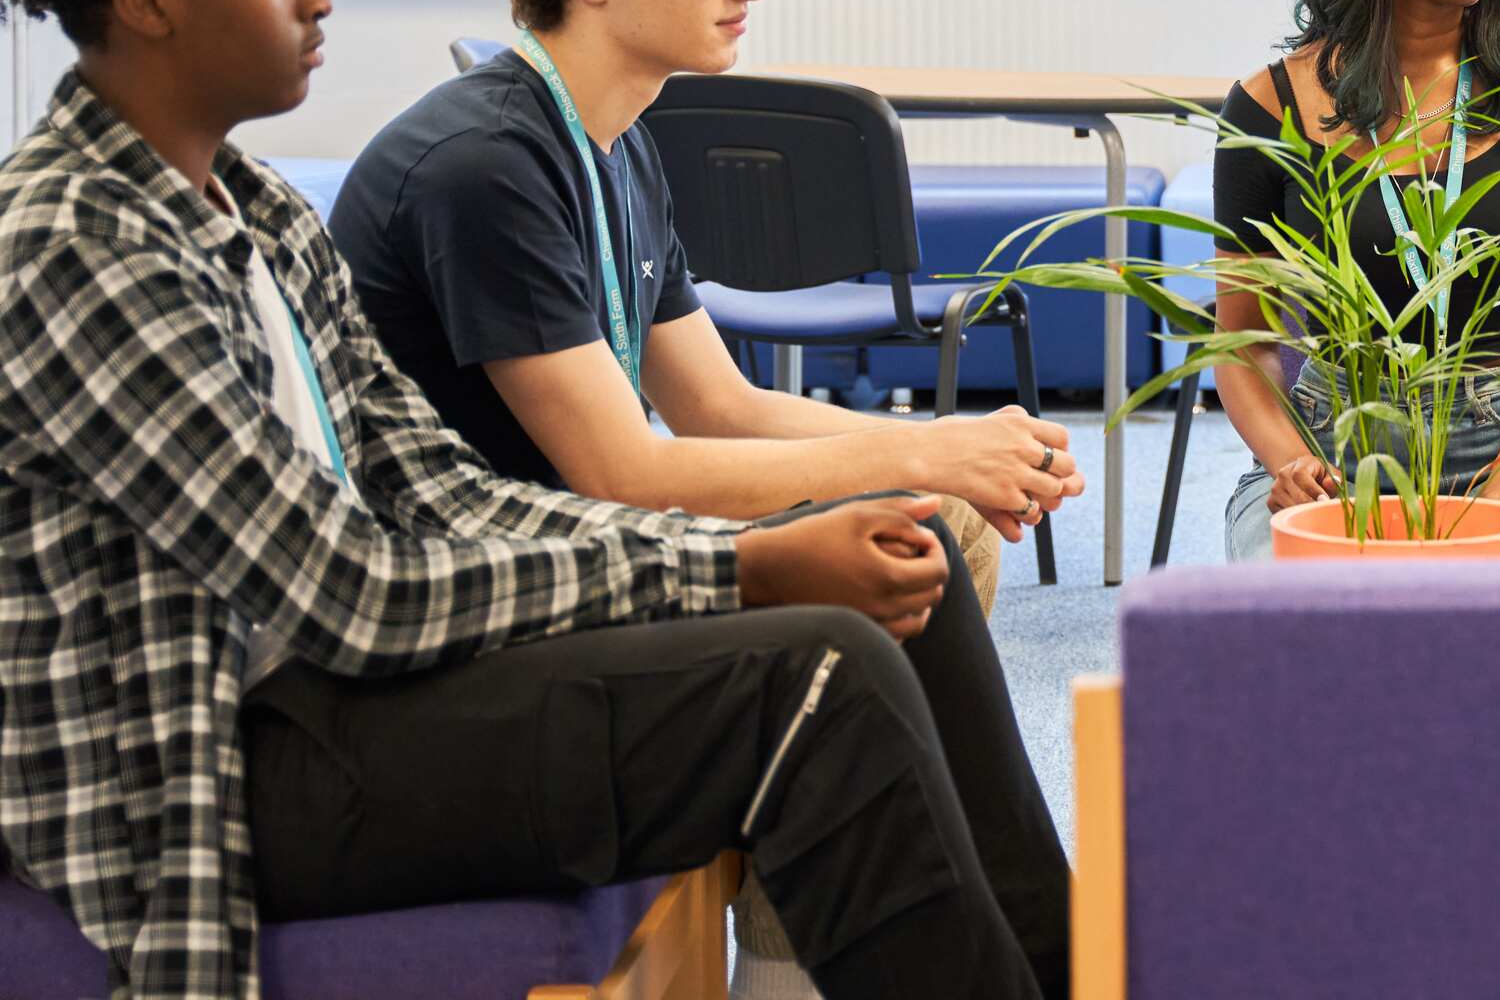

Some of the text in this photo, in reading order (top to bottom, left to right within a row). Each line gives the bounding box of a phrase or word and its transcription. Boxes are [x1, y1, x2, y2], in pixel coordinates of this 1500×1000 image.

[549, 71, 578, 122] Chiswick
[611, 288, 621, 320] Form
[614, 321, 627, 350] Sixth
